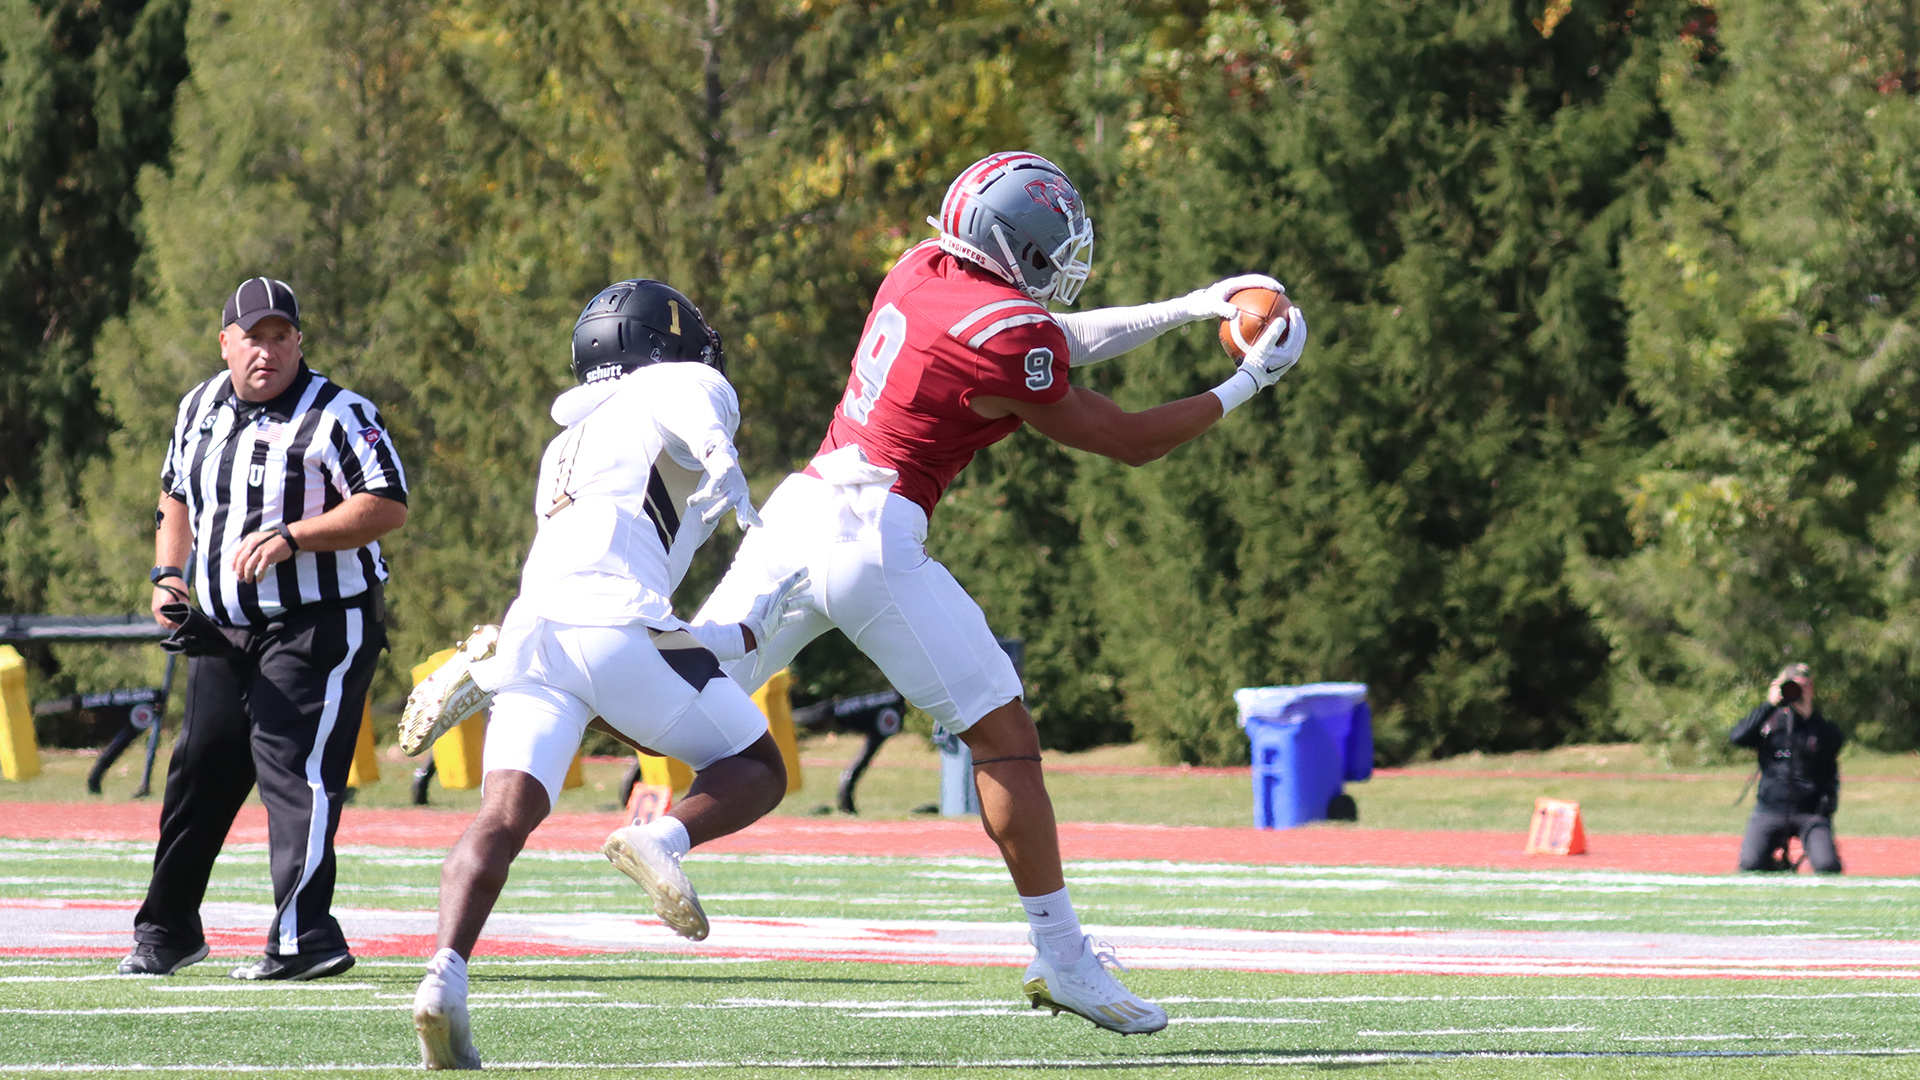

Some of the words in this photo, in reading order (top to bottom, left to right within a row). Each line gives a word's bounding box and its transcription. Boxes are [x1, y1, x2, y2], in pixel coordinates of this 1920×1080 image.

[949, 240, 986, 265] ENGINEERS
[667, 300, 681, 336] 1
[586, 364, 622, 383] schutt
[844, 302, 907, 426] 9
[1024, 347, 1054, 391] 9
[249, 464, 265, 487] U
